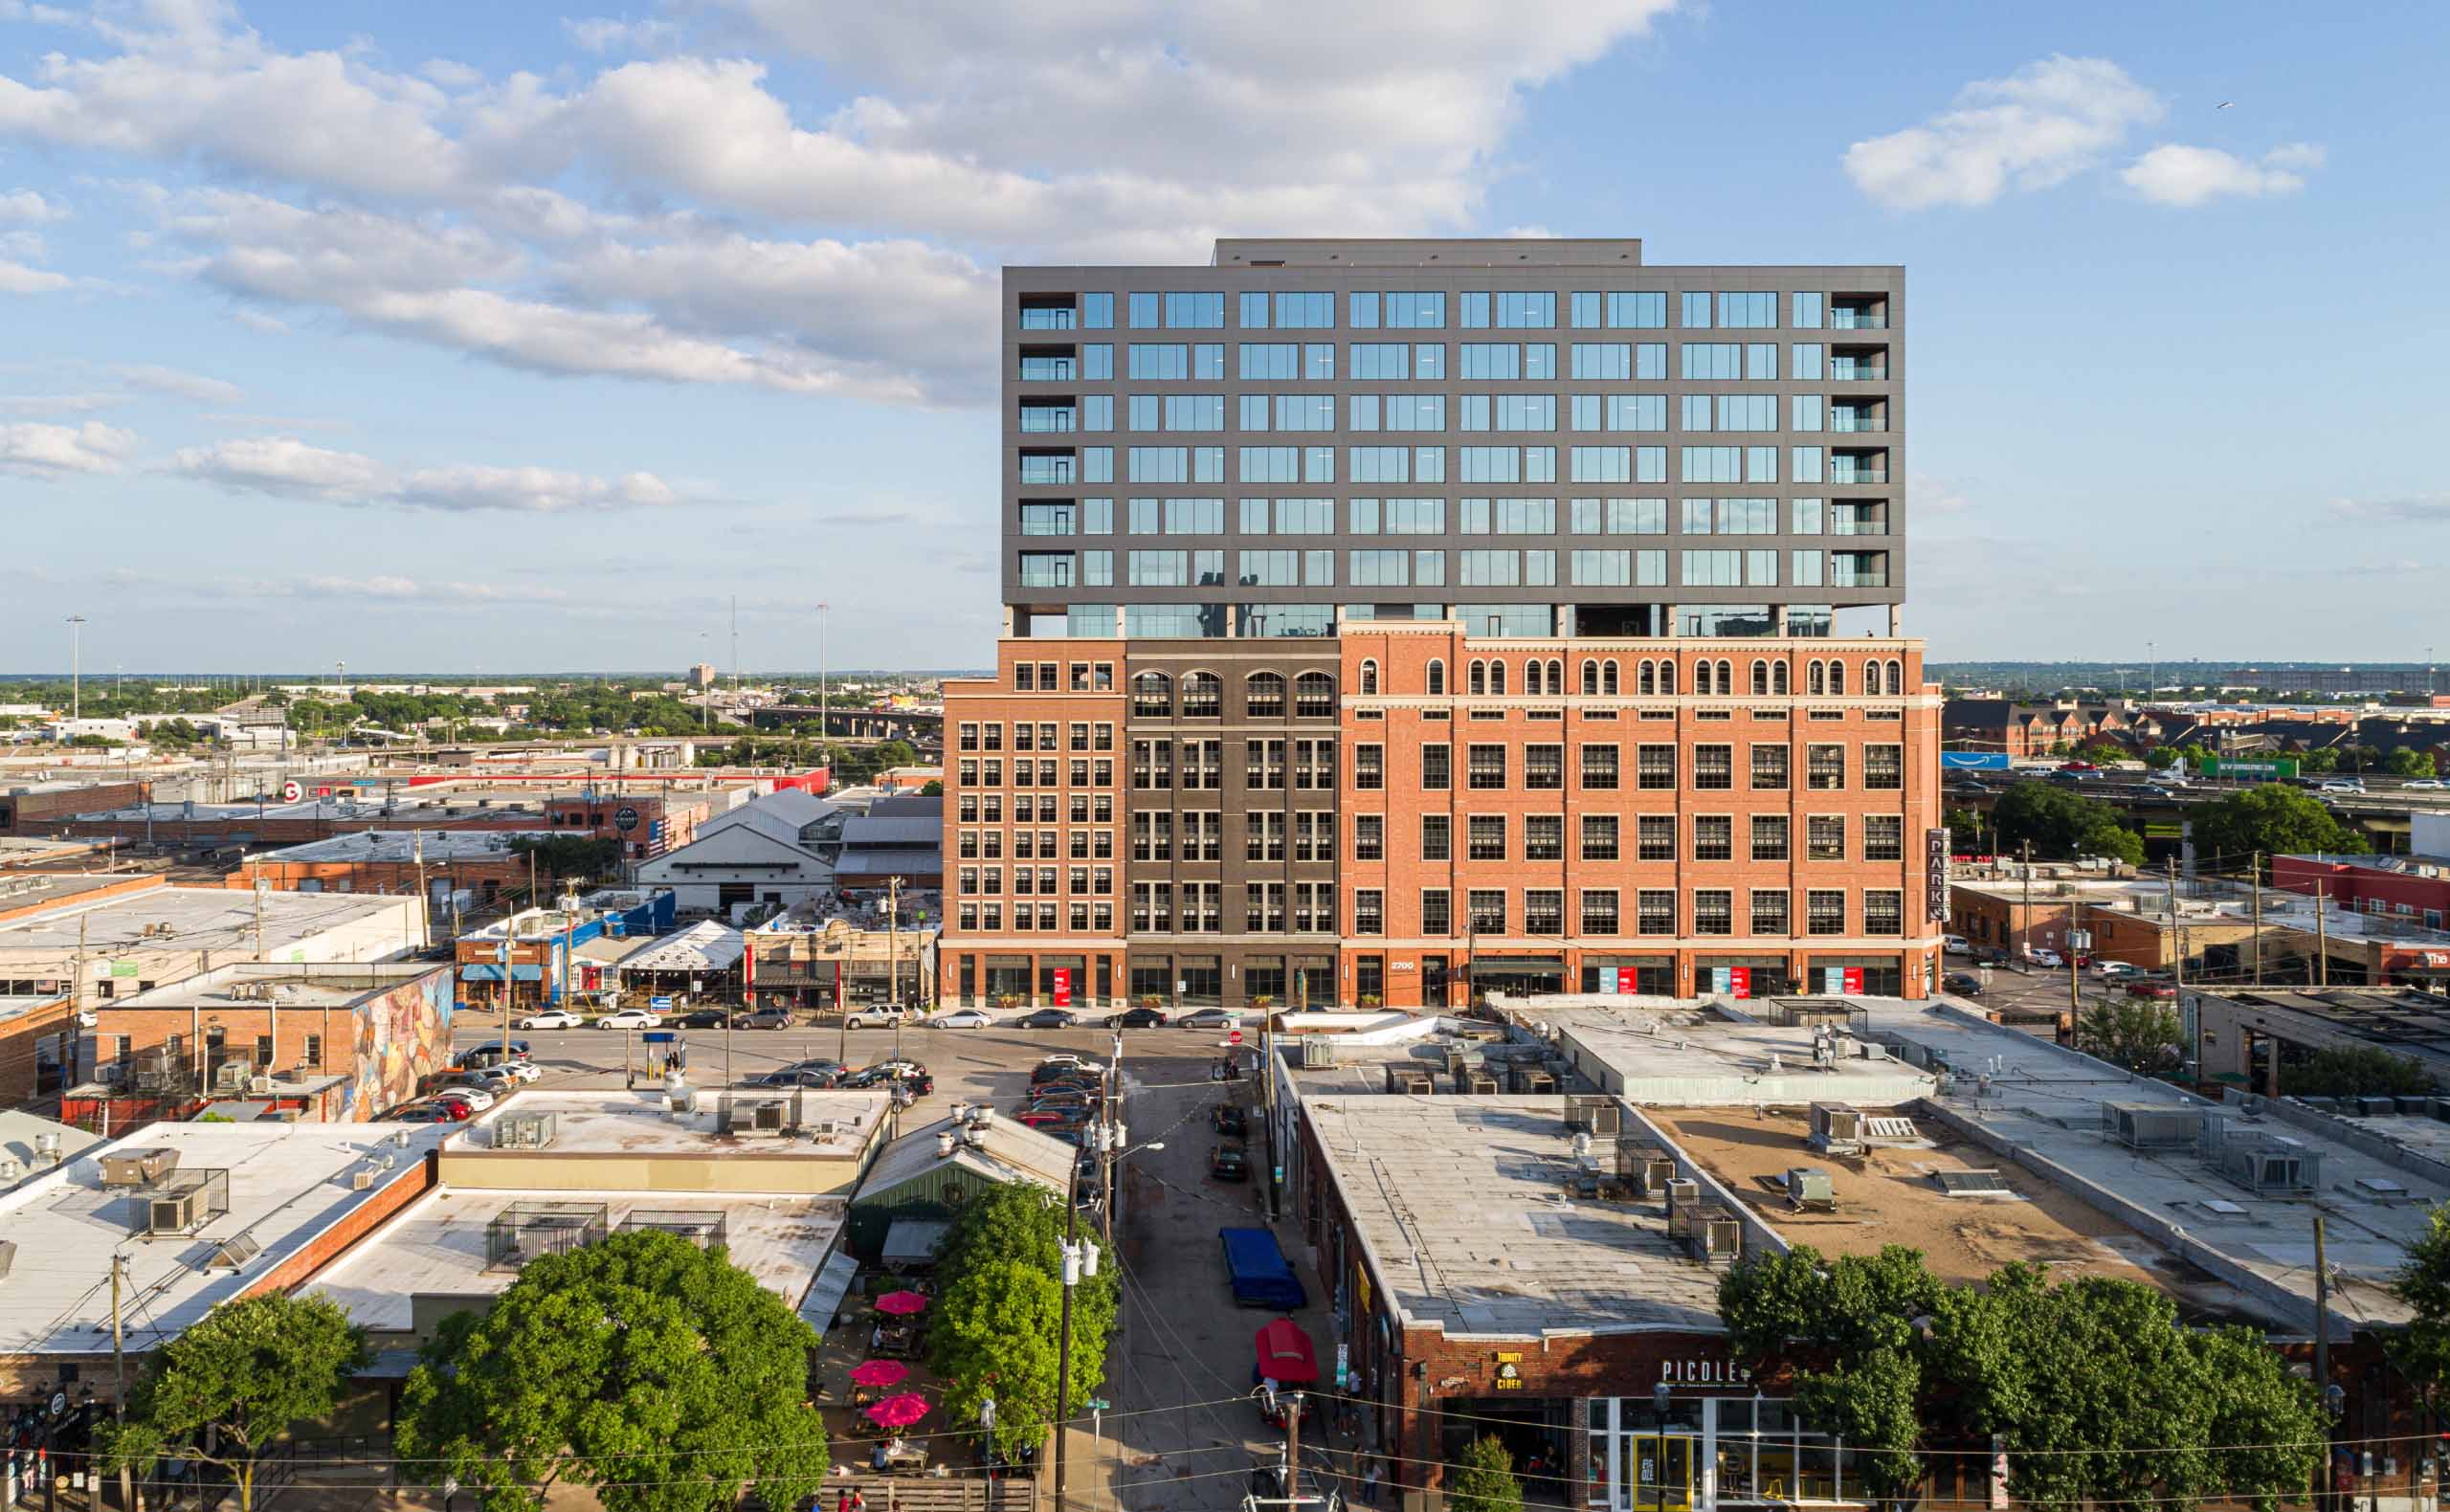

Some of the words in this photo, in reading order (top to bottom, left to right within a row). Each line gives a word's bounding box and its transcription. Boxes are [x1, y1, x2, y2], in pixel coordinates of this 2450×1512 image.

[1930, 839, 1942, 902] PARK
[1392, 962, 1414, 970] 2700
[1497, 1379, 1523, 1390] CIDER
